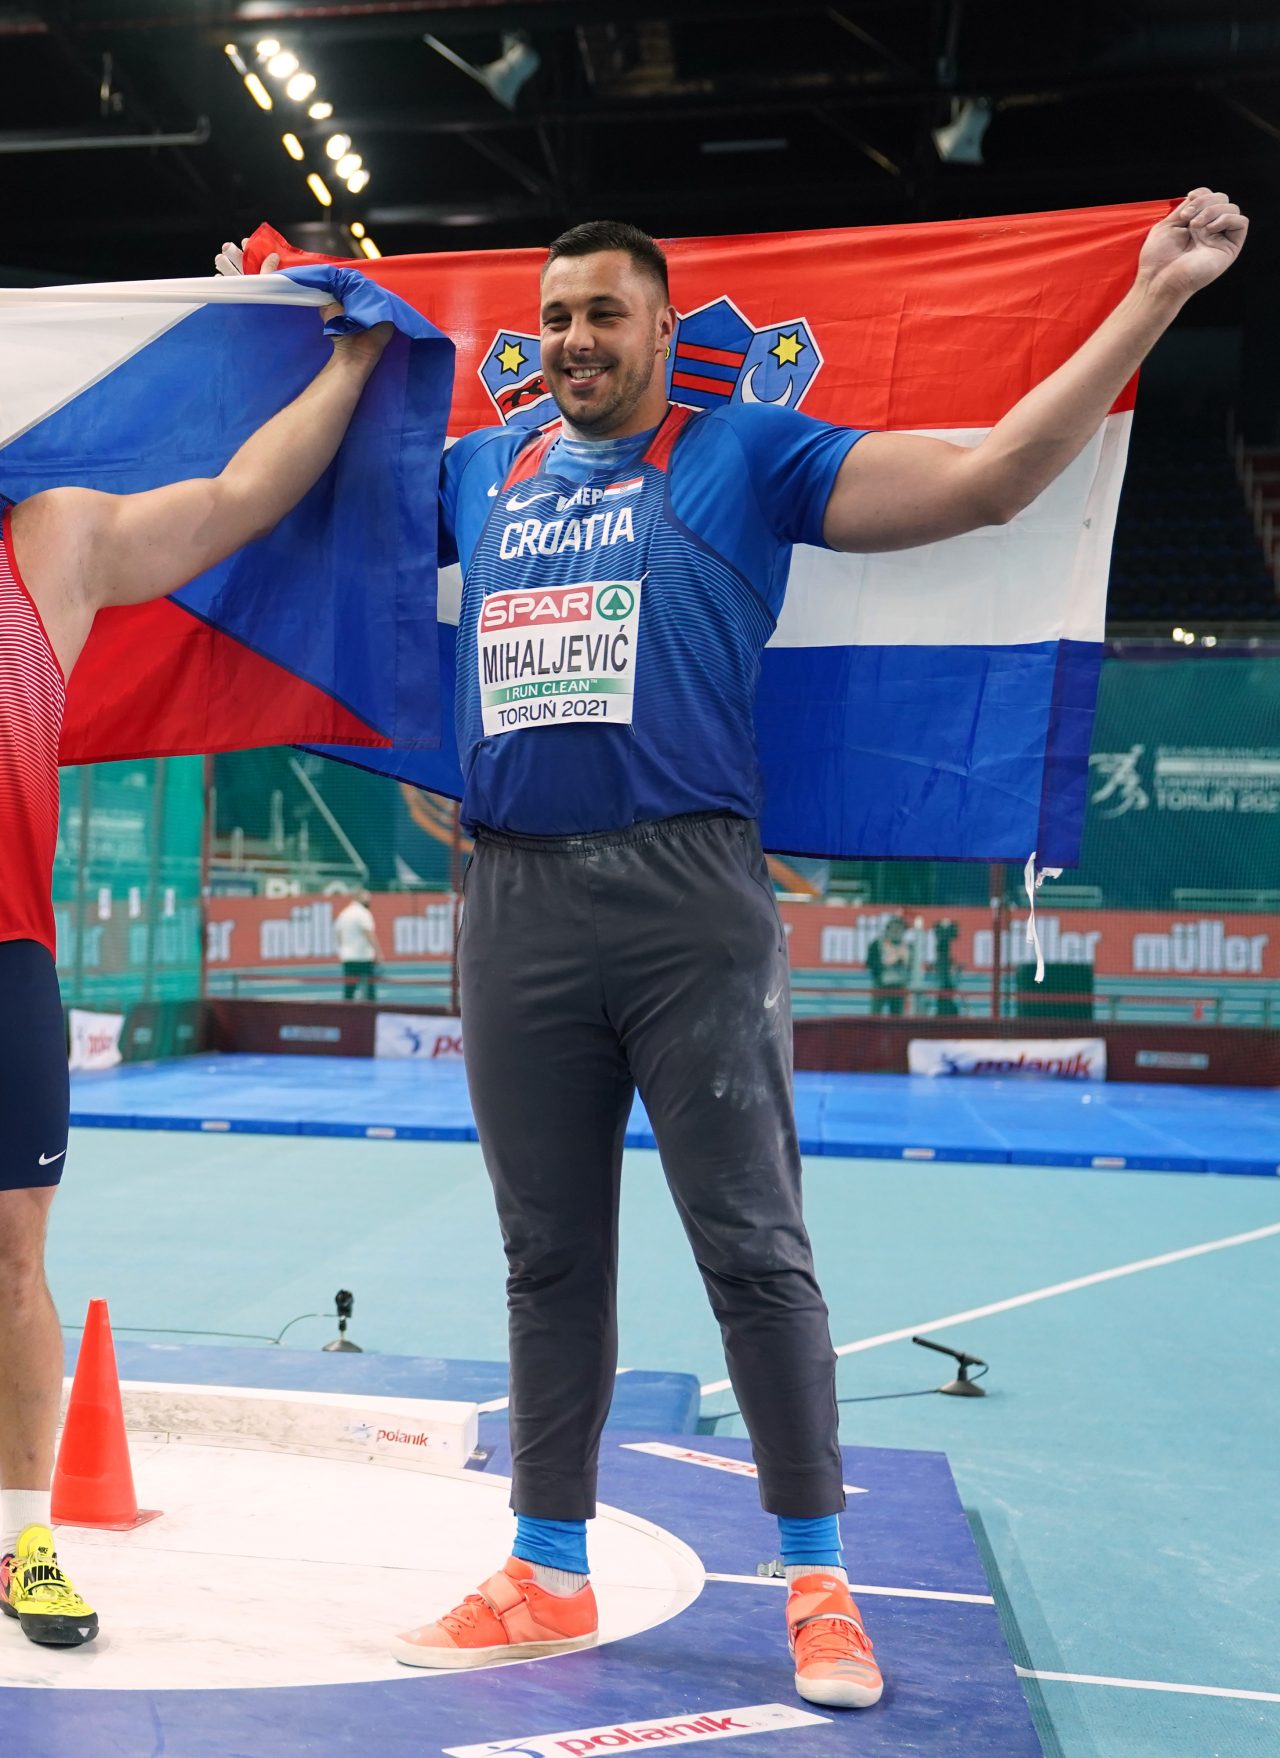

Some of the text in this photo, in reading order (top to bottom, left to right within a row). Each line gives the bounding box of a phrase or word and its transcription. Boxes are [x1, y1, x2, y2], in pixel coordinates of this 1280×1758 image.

[500, 507, 635, 560] CROATIA
[483, 591, 590, 627] SPAR
[482, 625, 629, 685] MIHALJEVIĆ
[513, 685, 538, 699] RUN
[498, 699, 608, 727] TORUŃ 2021
[1133, 920, 1269, 973] müller
[376, 1429, 430, 1447] polanik
[23, 1565, 66, 1590] NIKE
[553, 1715, 752, 1757] polanik
